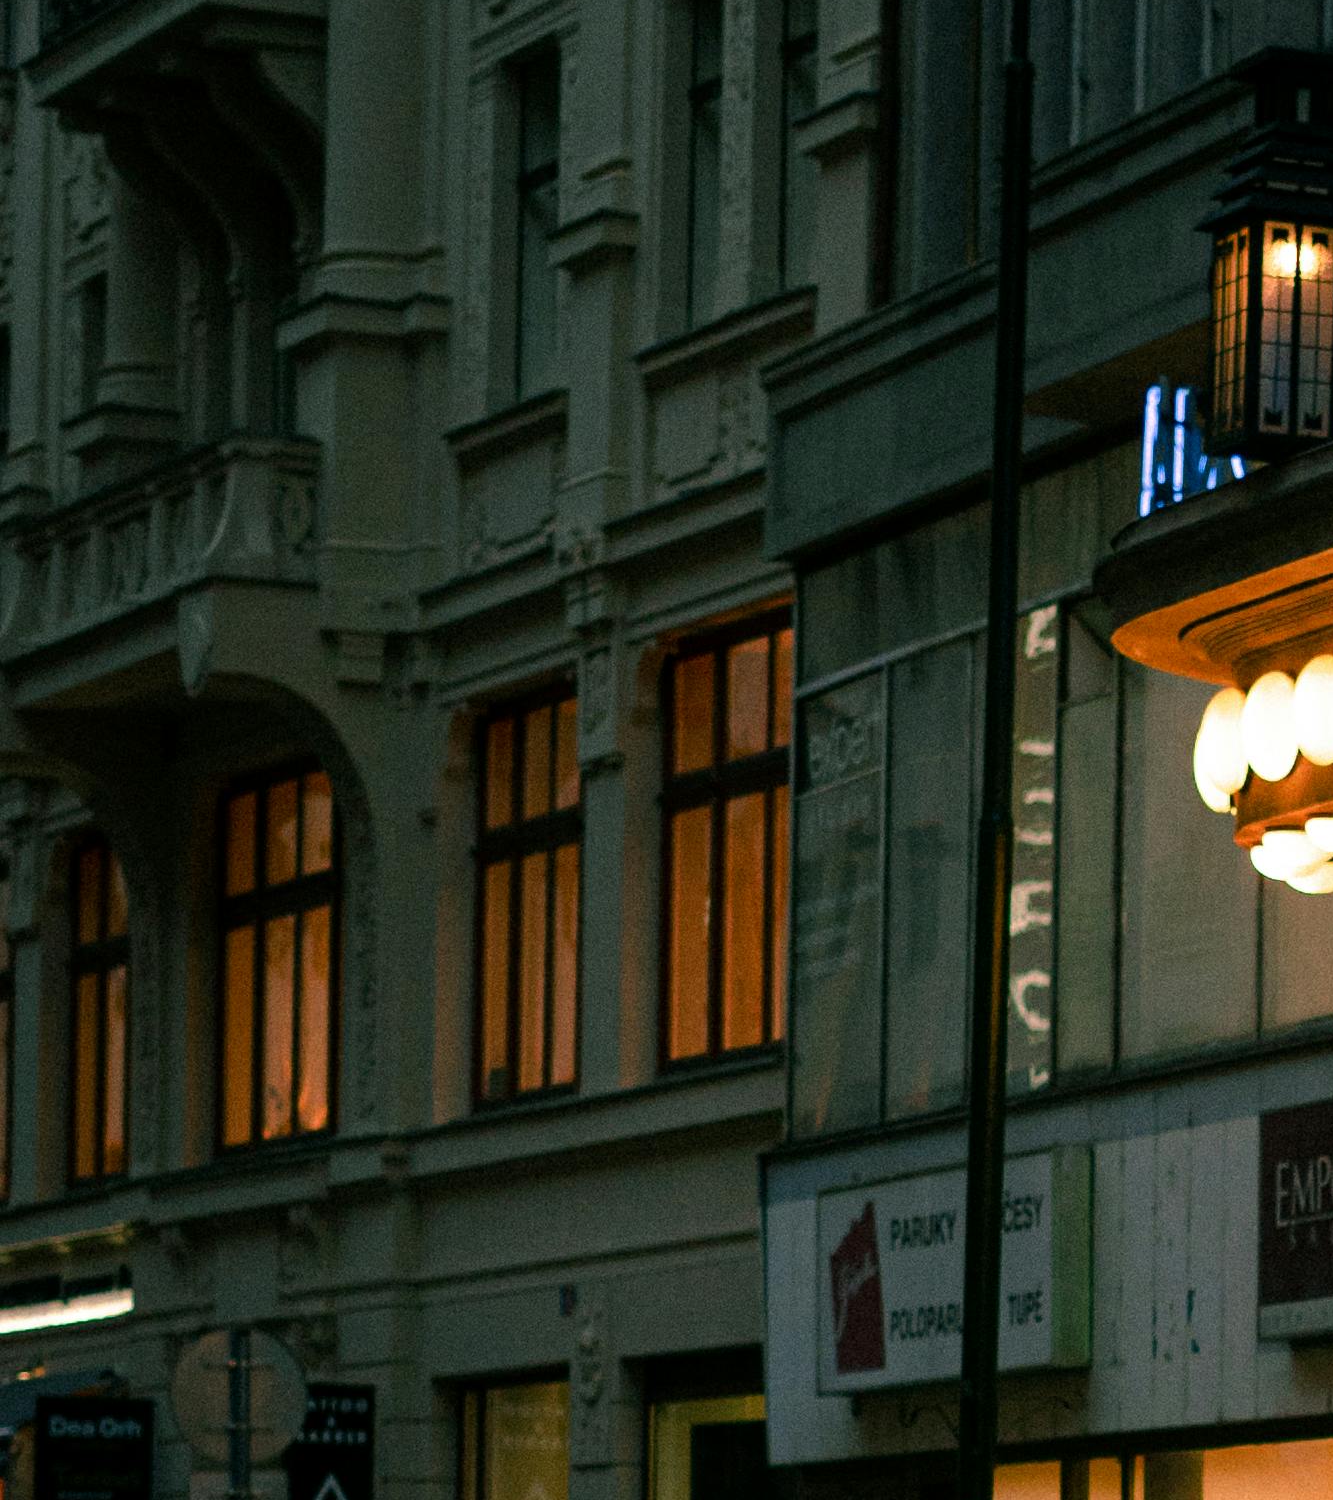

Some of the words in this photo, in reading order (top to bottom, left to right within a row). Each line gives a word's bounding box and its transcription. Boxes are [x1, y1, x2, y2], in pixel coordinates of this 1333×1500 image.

[891, 1212, 957, 1250] PARUKY
[1001, 1190, 1045, 1234] ČESY
[891, 1303, 965, 1341] POLOPARU
[307, 1397, 370, 1415] ATTOO
